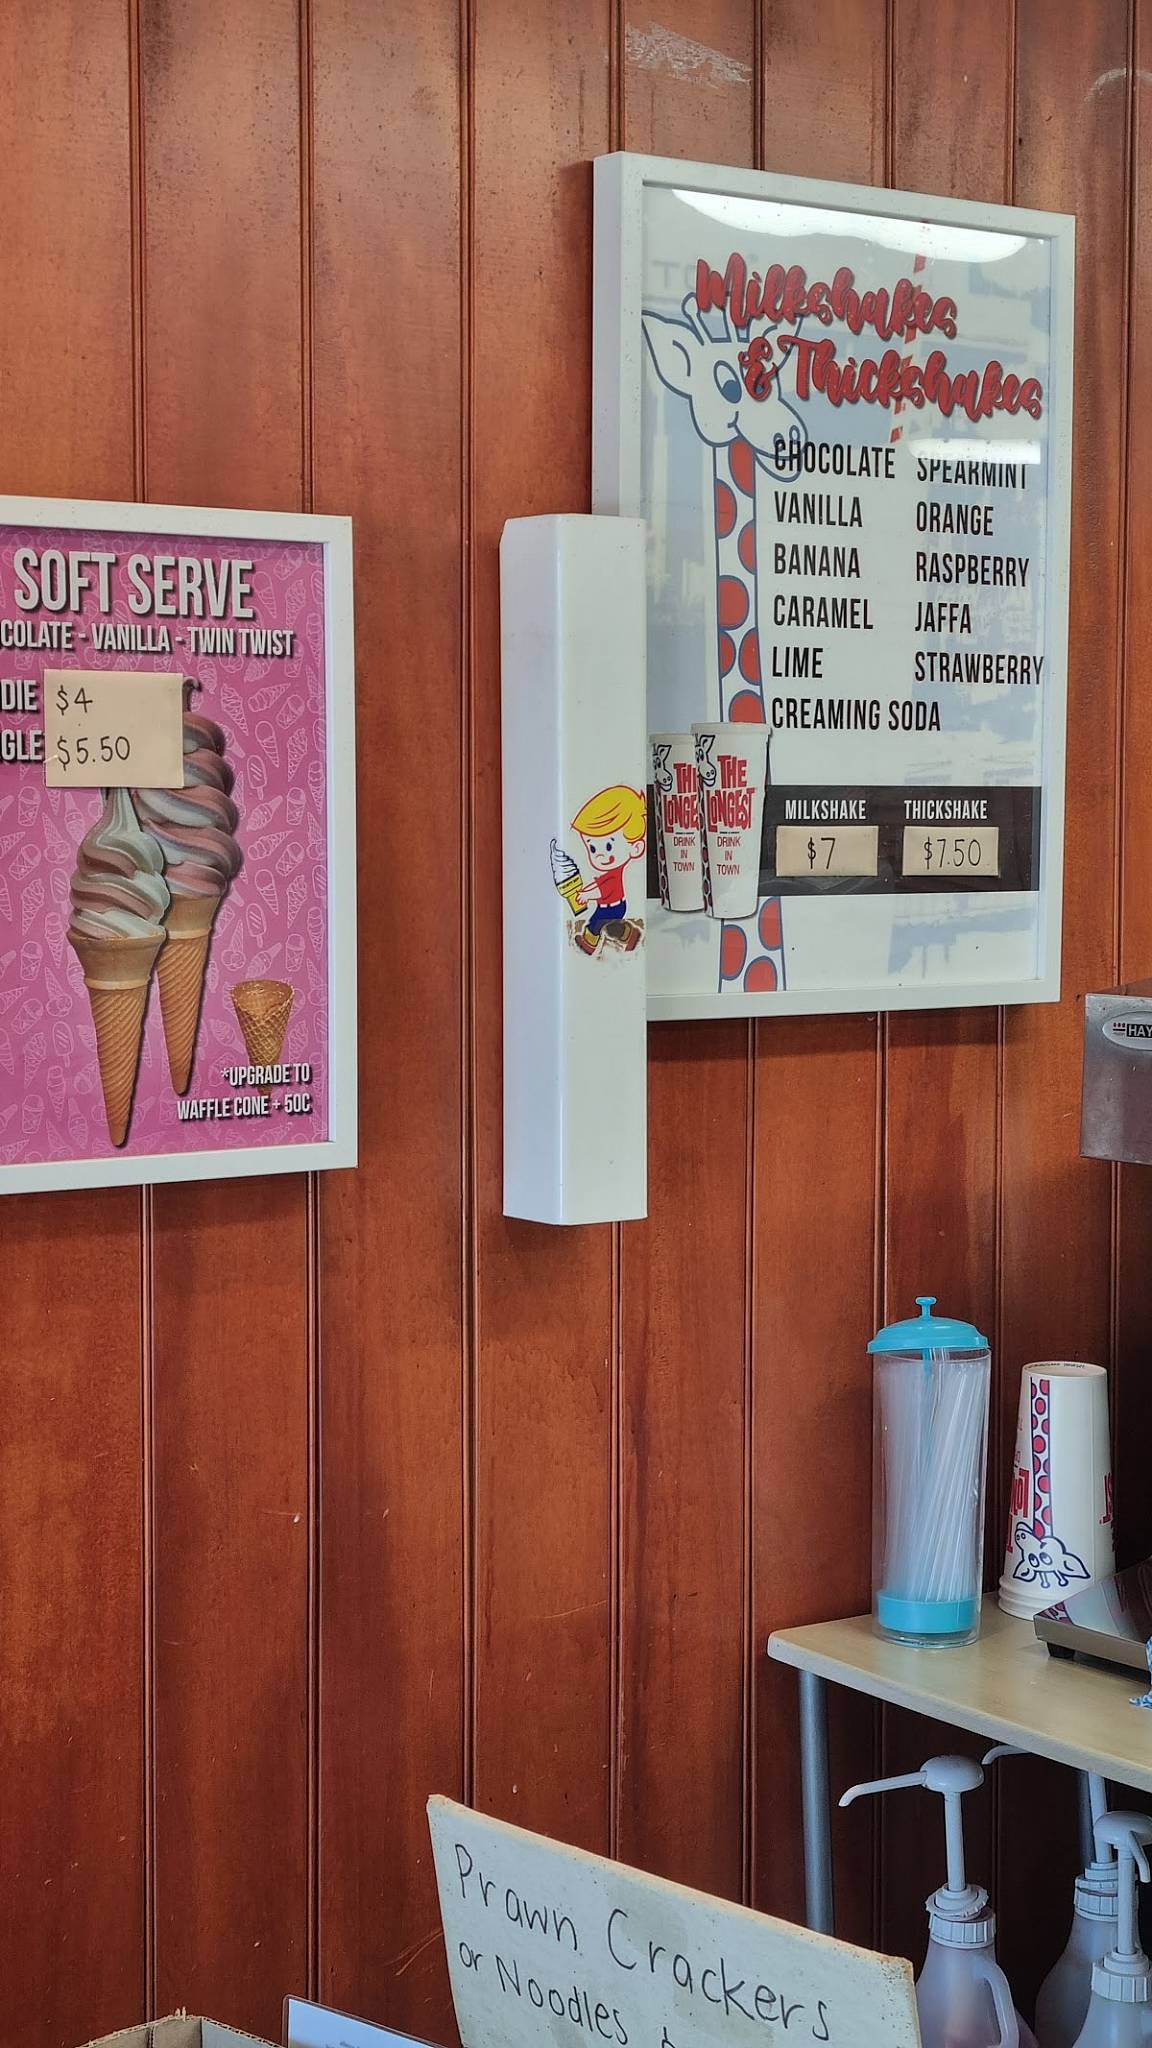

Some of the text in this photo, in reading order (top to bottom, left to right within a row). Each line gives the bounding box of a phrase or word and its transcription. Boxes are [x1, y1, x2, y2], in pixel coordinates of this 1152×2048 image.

[695, 252, 957, 341] Milkshakes
[738, 335, 1042, 422] & Thickshakes
[774, 439, 896, 479] CHOCOLATE
[916, 455, 1029, 489] SPEARMINT
[774, 491, 863, 528] VANILLA
[916, 501, 994, 536] ORANGE
[774, 543, 861, 578] BANANA
[916, 551, 1029, 587] RASPBERRY
[14, 548, 254, 619] SOFT SERVE
[773, 595, 873, 630] CARAMEL
[914, 602, 972, 634] JAFFA
[92, 623, 170, 652] VANILLA
[187, 626, 234, 655] TWIN
[241, 628, 294, 656] TWIST
[772, 646, 824, 679] LIME
[914, 651, 1045, 685] STRAWBERRY
[56, 685, 93, 715] $4
[771, 697, 941, 731] CREAMING SODA
[57, 735, 131, 771] $5.50
[717, 755, 747, 789] THE
[706, 788, 756, 832] LONGEST
[785, 799, 867, 820] MILKSHAKE
[904, 799, 988, 820] THICKSHAKE
[673, 836, 696, 847] DRINK
[680, 849, 688, 859] IN
[717, 836, 741, 847] DRINK
[724, 850, 733, 861] IN
[807, 836, 837, 870] $7
[923, 836, 983, 870] $7.50
[673, 862, 695, 872] TOWN
[717, 864, 740, 875] TOWN
[294, 1063, 310, 1082] TO
[177, 1099, 231, 1121] WAFFLE
[234, 1095, 268, 1116] CONE
[454, 1843, 829, 2041] Prawn Crackers
[458, 1940, 628, 2046] or Noodles
